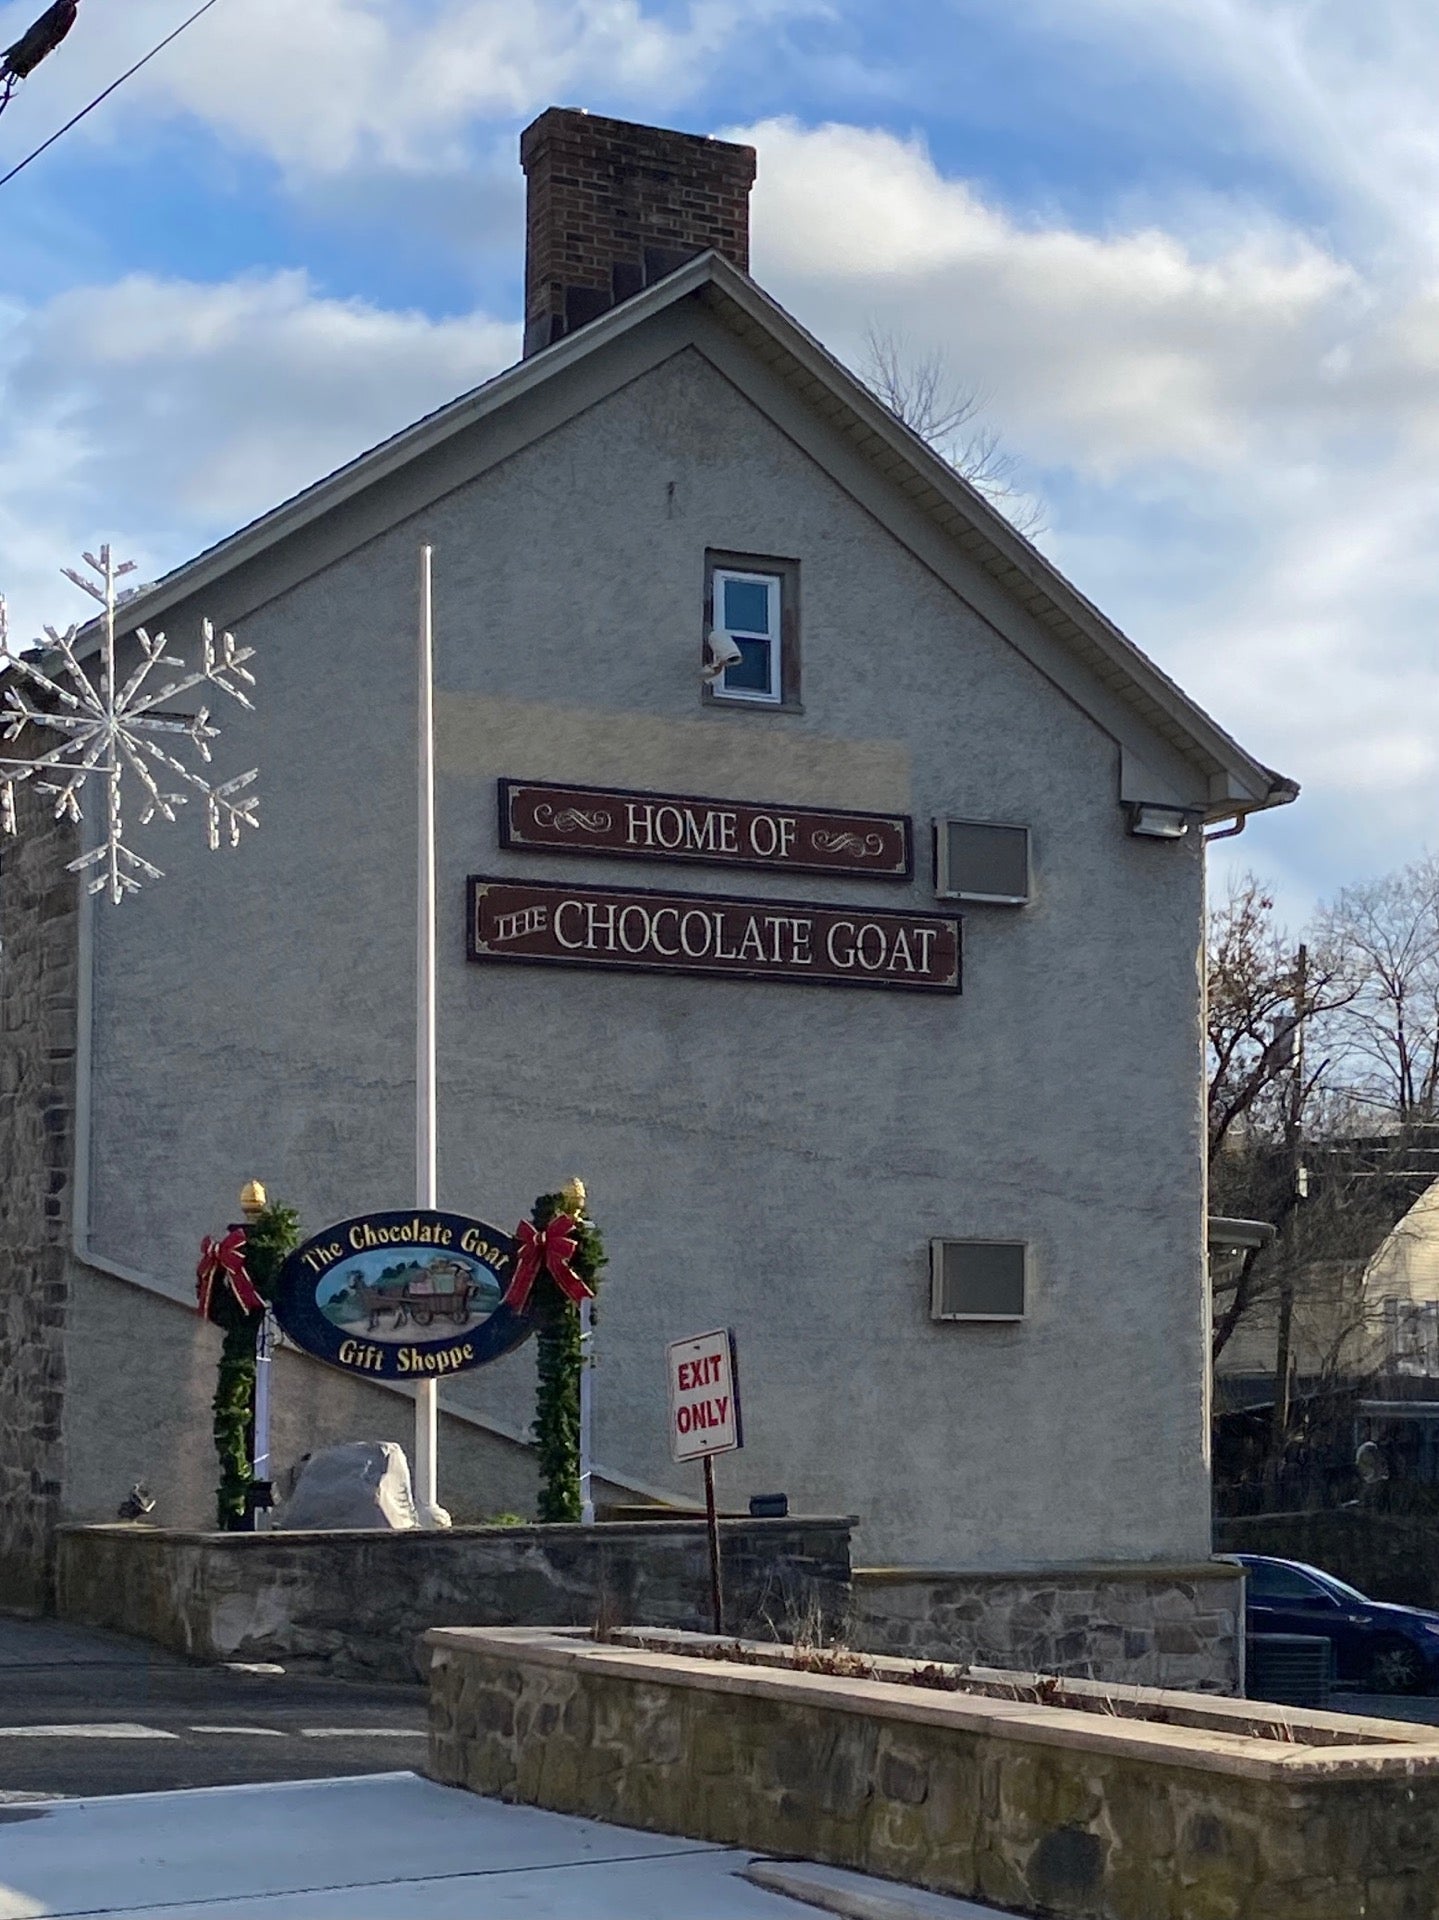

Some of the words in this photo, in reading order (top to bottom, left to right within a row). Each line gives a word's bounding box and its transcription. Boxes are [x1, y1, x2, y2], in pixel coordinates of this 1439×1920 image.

[624, 803, 739, 853] HOME
[749, 815, 797, 857] OF
[494, 905, 548, 942] THE
[553, 899, 813, 965] CHOCOLATE
[826, 920, 937, 974] GOAT
[301, 1242, 343, 1272] The
[349, 1219, 453, 1248] Chocolate
[460, 1228, 510, 1271] Goat
[338, 1339, 384, 1371] Gift
[396, 1343, 474, 1373] Shoppe
[678, 1354, 722, 1391] EXIT
[677, 1396, 728, 1434] ONLY
